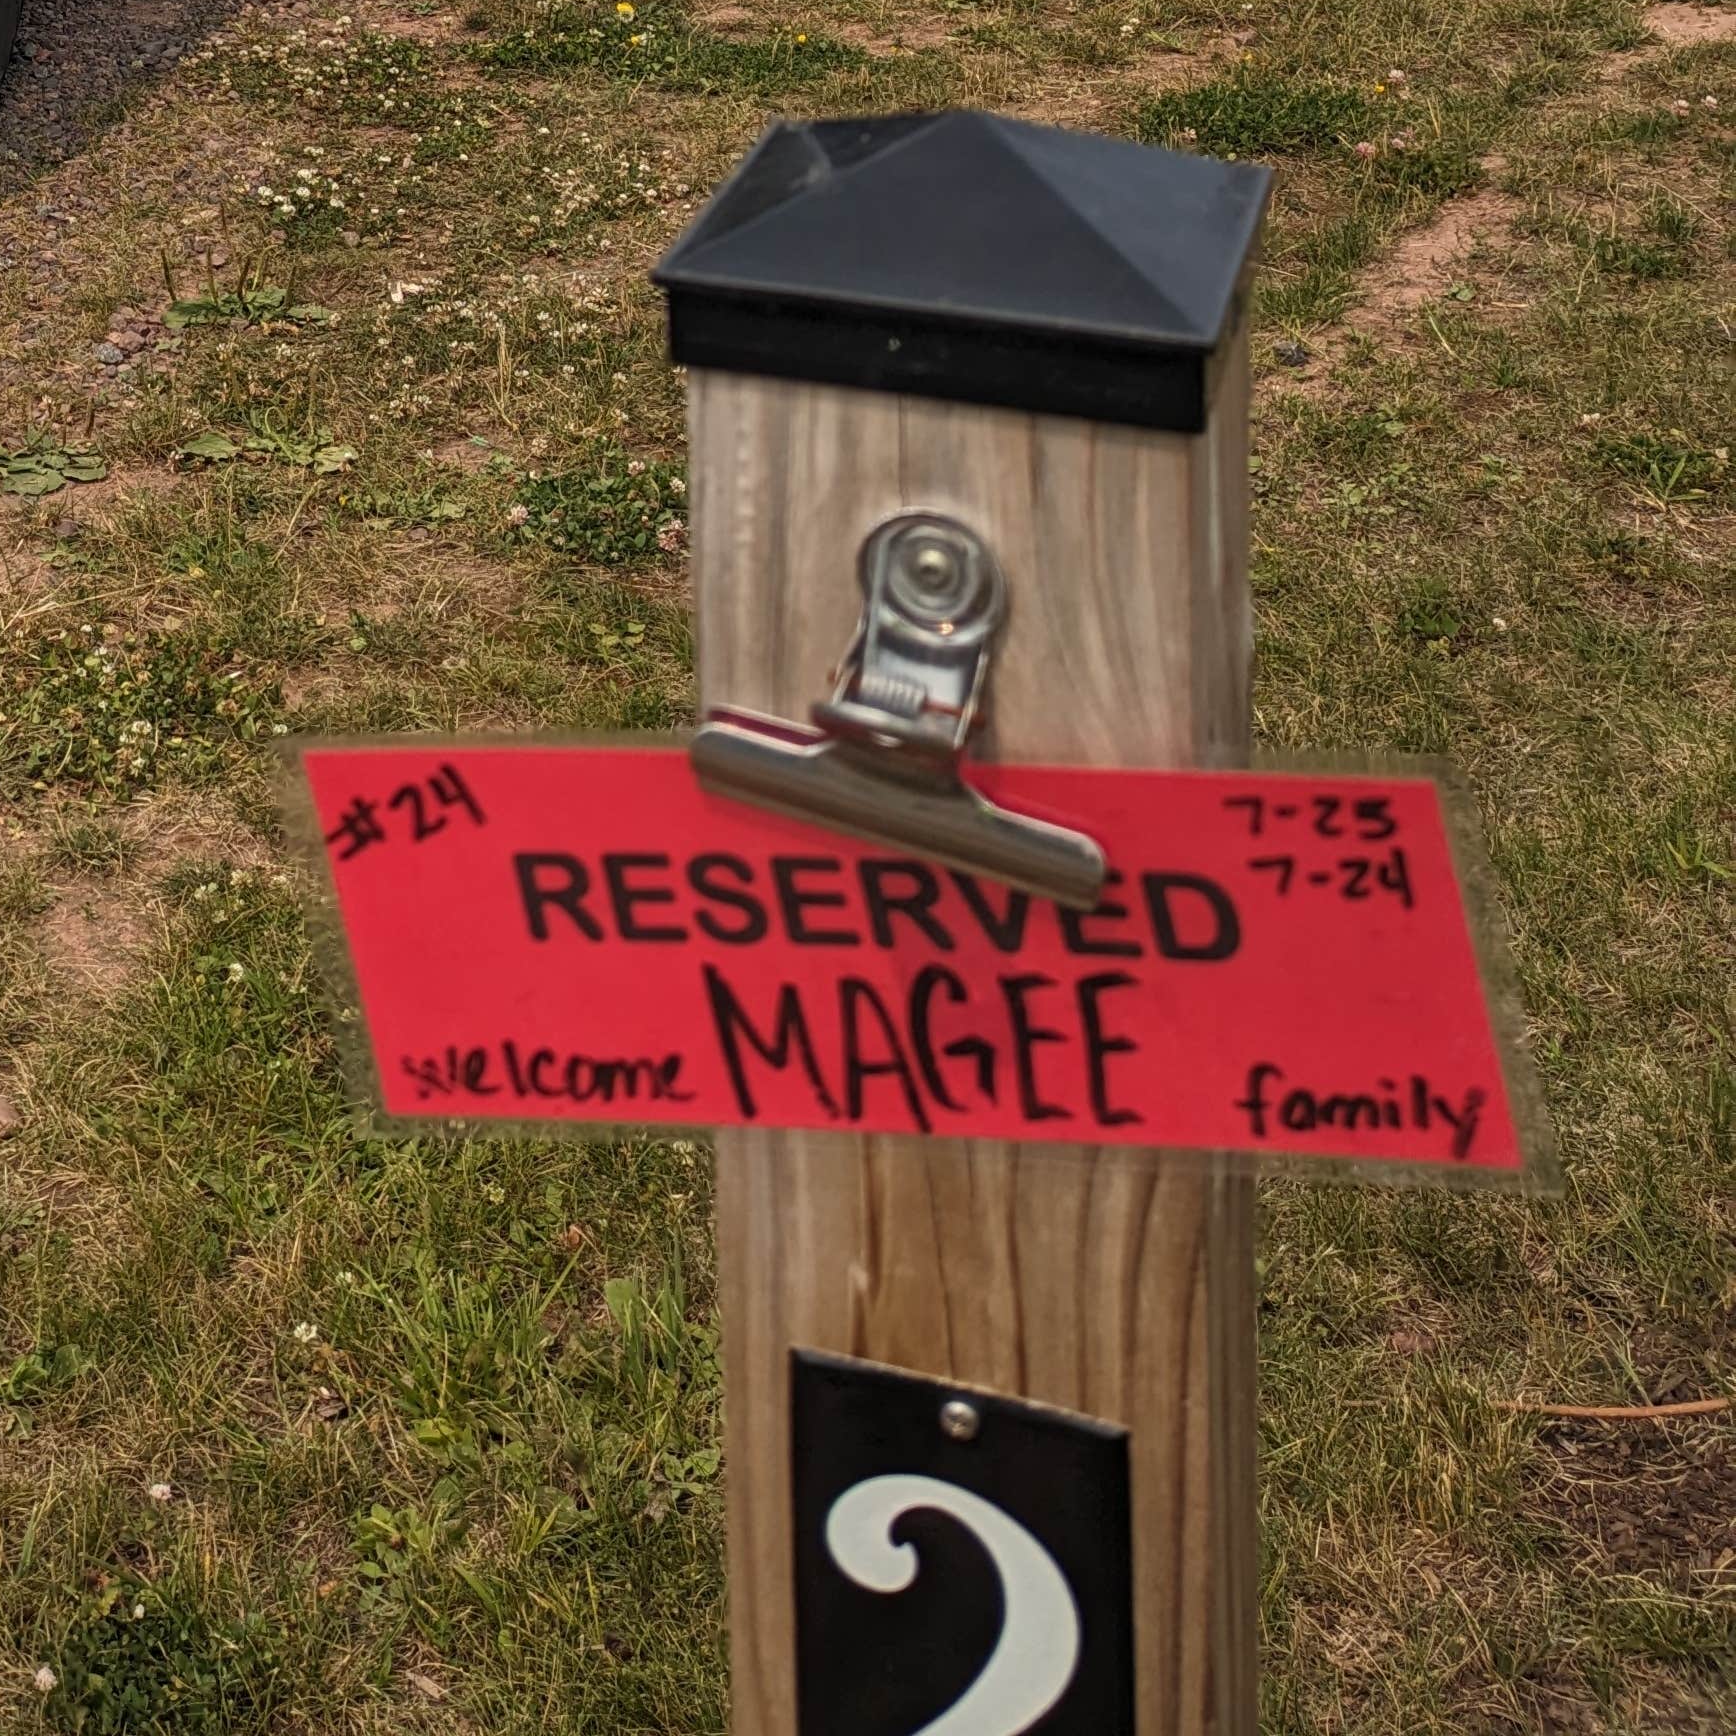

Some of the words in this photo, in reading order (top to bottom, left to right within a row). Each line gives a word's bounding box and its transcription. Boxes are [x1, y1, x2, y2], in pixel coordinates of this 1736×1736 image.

[324, 760, 489, 862] #24
[511, 850, 1243, 963] RESERVED
[1247, 844, 1416, 910] 7-24
[701, 962, 1145, 1135] MAGEE
[1233, 1061, 1488, 1162] family
[825, 1472, 1081, 1736] 2
